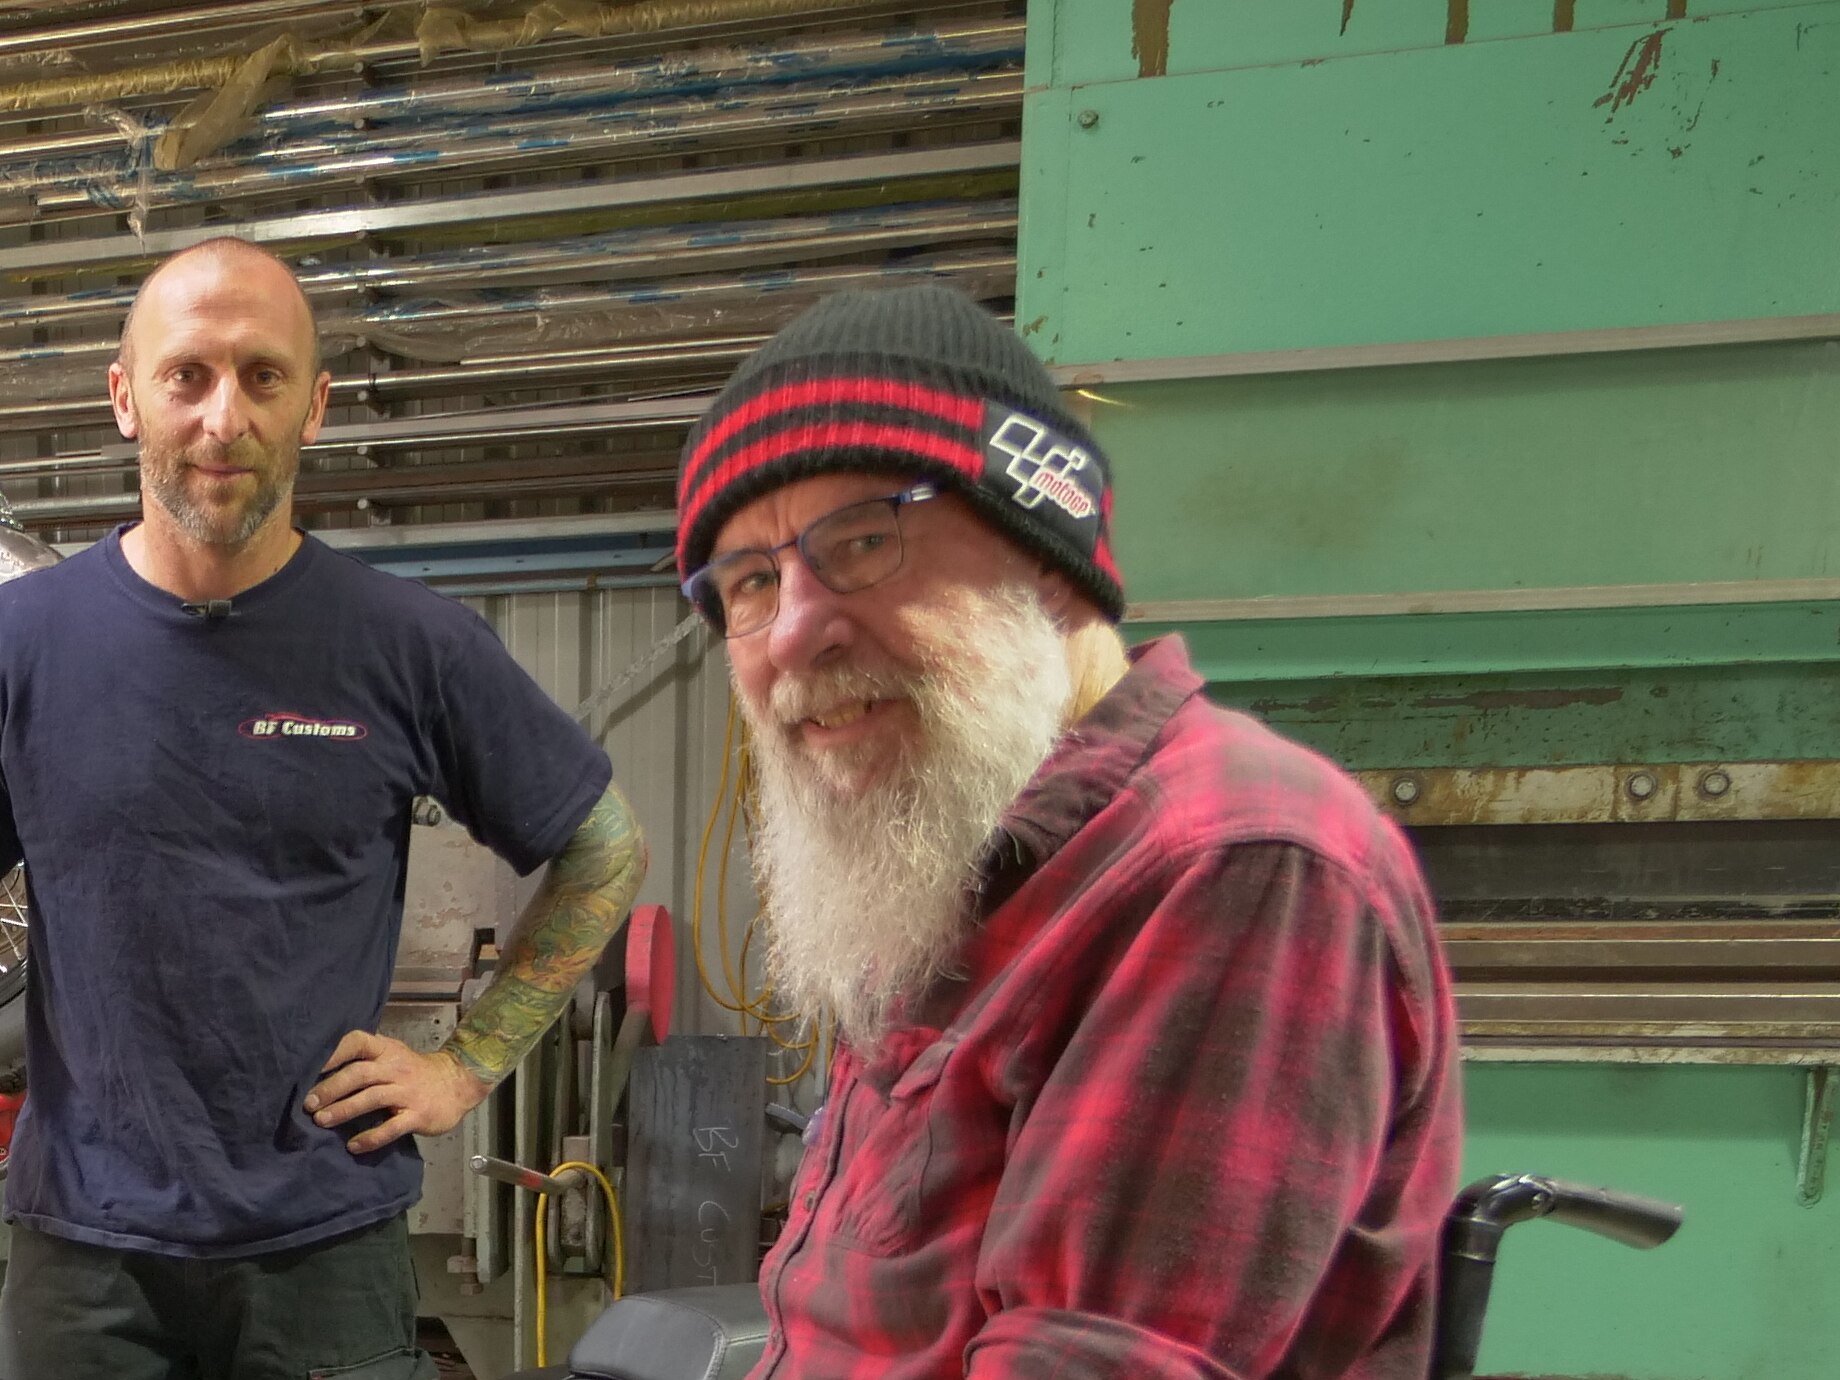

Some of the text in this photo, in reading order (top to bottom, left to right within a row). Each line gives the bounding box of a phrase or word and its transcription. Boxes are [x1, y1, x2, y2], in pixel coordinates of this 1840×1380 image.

[253, 720, 356, 737] BF Customs
[693, 1127, 739, 1173] BF
